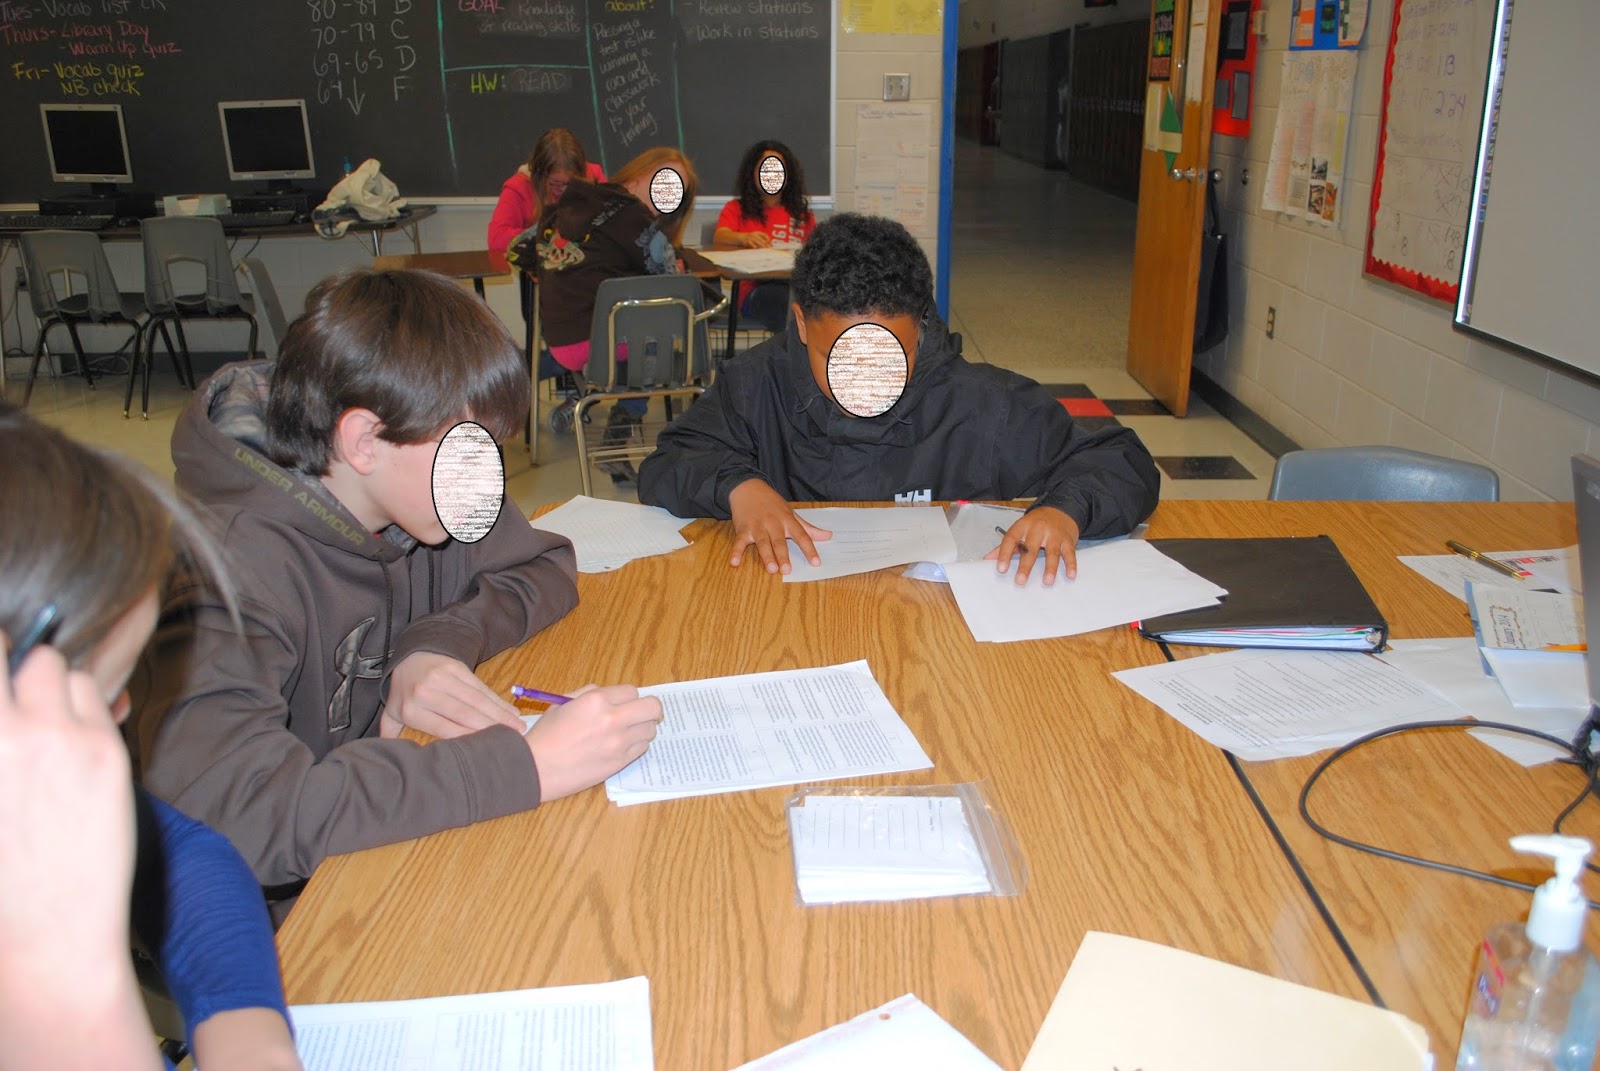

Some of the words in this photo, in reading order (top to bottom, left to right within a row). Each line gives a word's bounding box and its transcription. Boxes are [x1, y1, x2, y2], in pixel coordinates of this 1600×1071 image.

[116, 20, 149, 45] Day
[390, 18, 410, 39] C
[696, 22, 733, 43] Work
[738, 27, 751, 37] in
[394, 45, 416, 72] D
[53, 61, 101, 80] Vocab
[60, 81, 90, 97] NB
[93, 79, 141, 97] check
[393, 75, 411, 102] F
[234, 447, 293, 493] UNDER
[294, 490, 366, 546] ARMOUR
